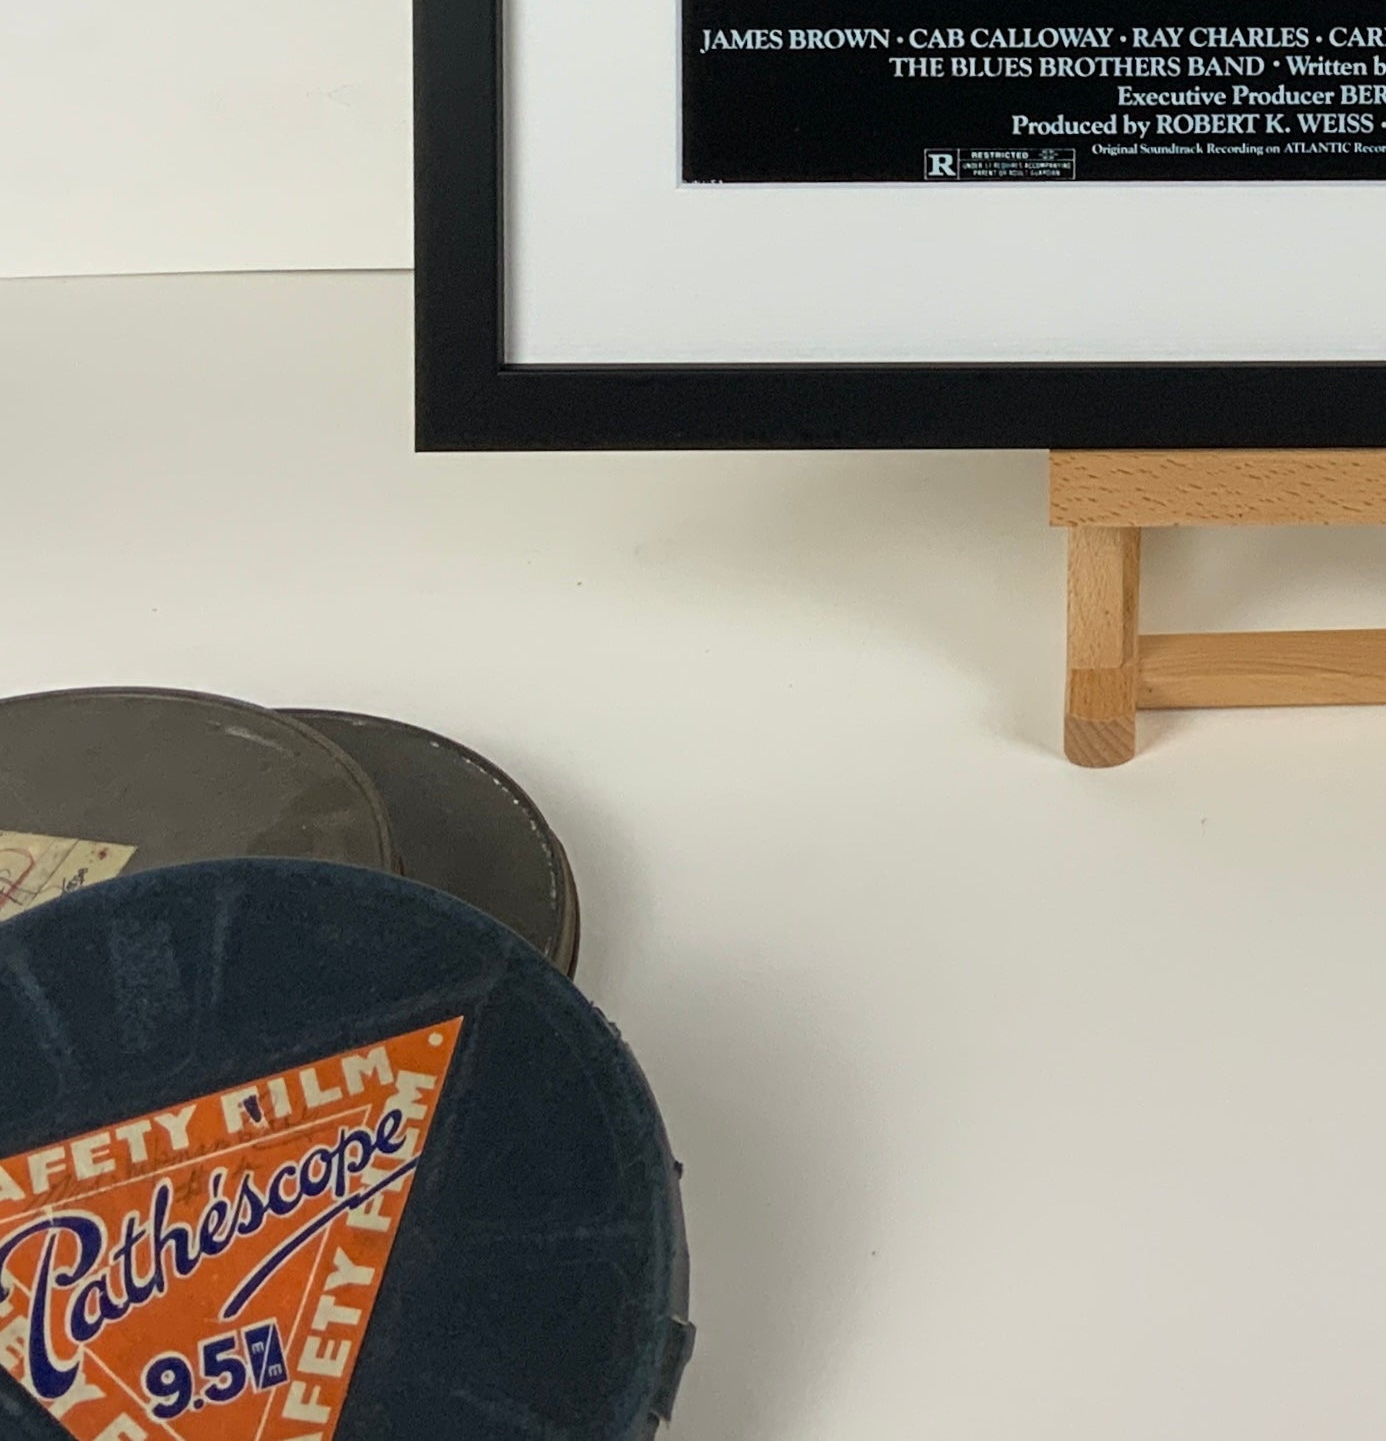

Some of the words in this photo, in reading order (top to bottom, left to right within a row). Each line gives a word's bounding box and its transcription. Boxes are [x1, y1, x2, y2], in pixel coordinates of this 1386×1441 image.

[699, 28, 784, 53] JAMES
[788, 27, 891, 51] BROWN
[909, 27, 965, 49] CAB
[970, 26, 1114, 49] CALLOWAY
[1132, 26, 1184, 49] RAY
[1189, 26, 1310, 49] CHARLES
[888, 57, 945, 78] THE
[951, 57, 1033, 78] BLUES
[1038, 56, 1181, 78] BROTHERS
[1187, 55, 1265, 77] BAND
[1285, 55, 1368, 76] Written
[1117, 84, 1227, 106] Executive
[1232, 84, 1335, 106] Producer
[1012, 114, 1118, 136] Produced
[1122, 114, 1151, 140] by
[1155, 113, 1260, 135] ROBERT
[1264, 113, 1291, 135] K.
[1296, 112, 1374, 134] WEISS
[971, 151, 1029, 160] RESTRICTED
[1091, 142, 1138, 156] Original
[1139, 142, 1204, 155] Soundtrack
[1206, 142, 1264, 156] Recording
[1265, 144, 1281, 154] on
[1283, 142, 1352, 154] ATLANTIC
[927, 153, 957, 177] R
[220, 1046, 394, 1134] FILM
[0, 1108, 406, 1402] Pathéscope
